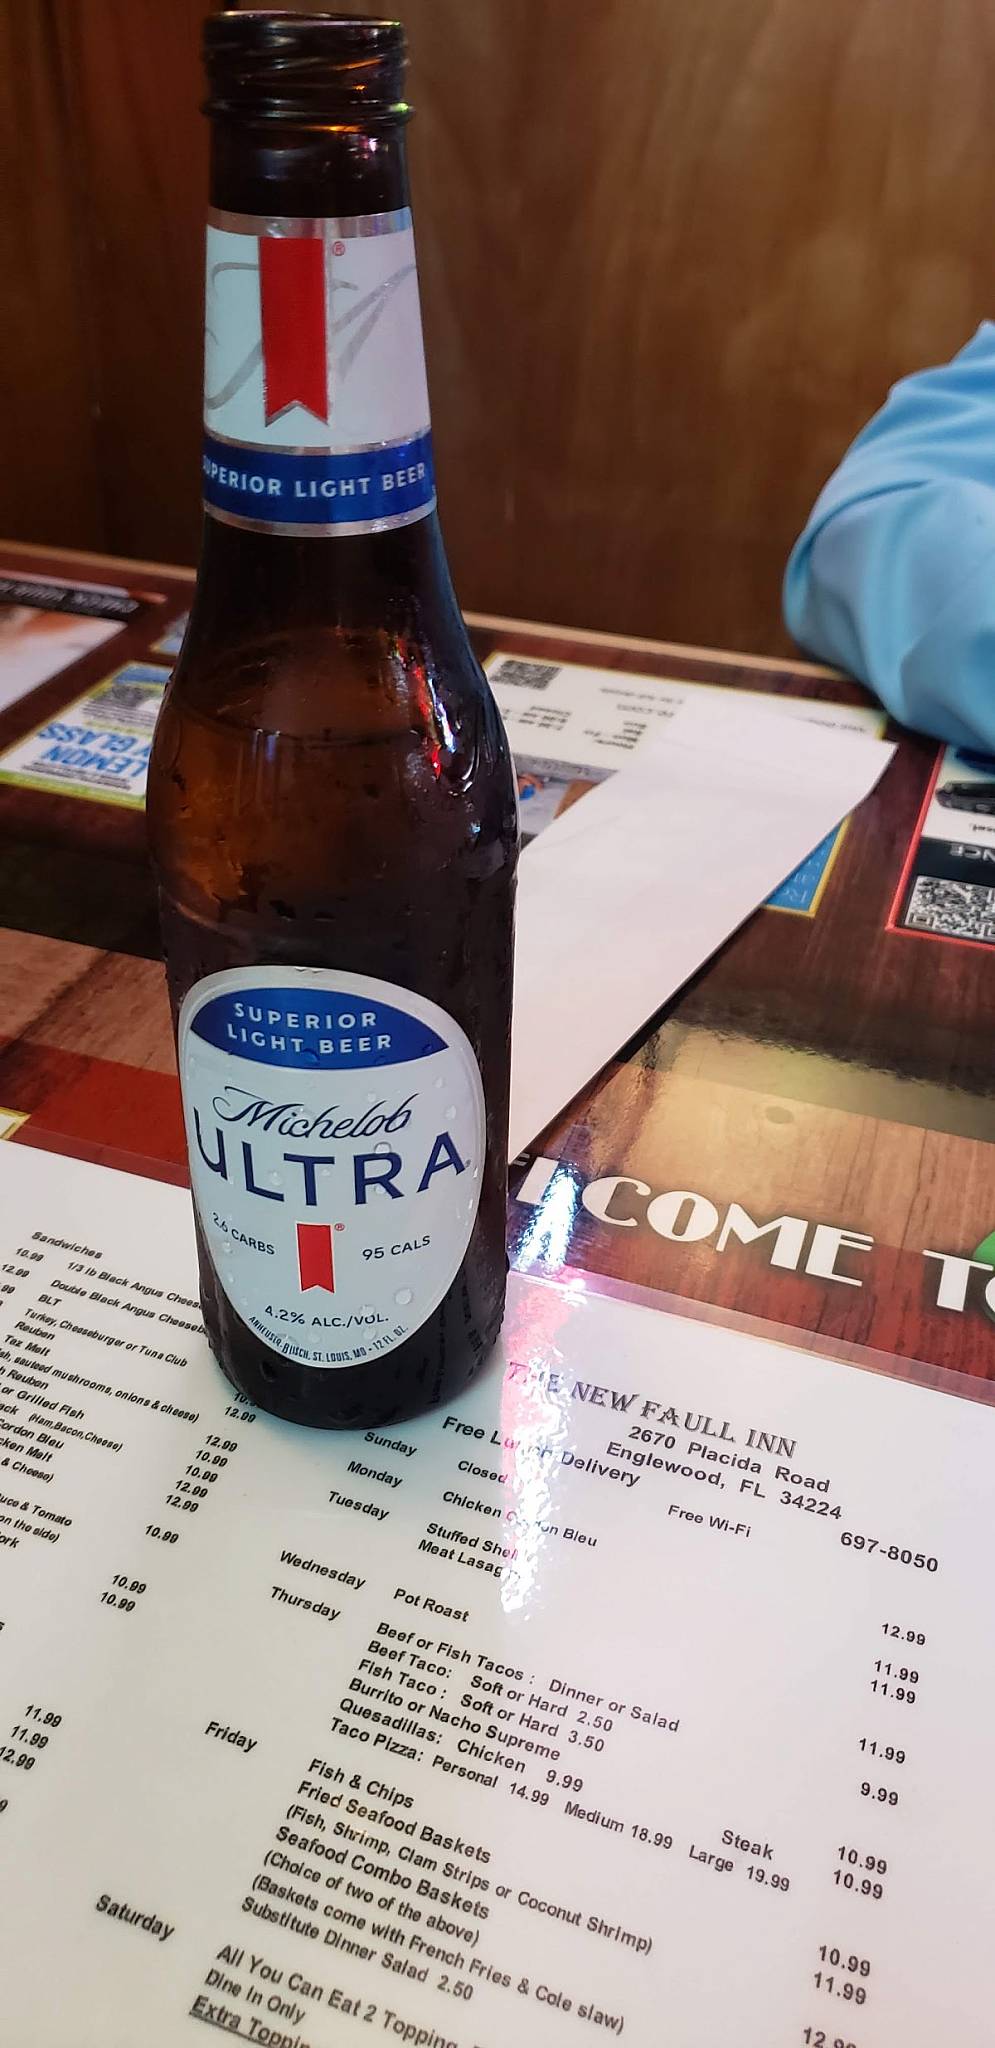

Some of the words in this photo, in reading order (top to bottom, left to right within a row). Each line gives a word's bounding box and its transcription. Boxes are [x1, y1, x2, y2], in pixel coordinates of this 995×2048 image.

[295, 478, 371, 498] LIGHT
[383, 462, 426, 491] BEER
[39, 723, 138, 751] GLASS
[43, 745, 148, 777] LEMON
[234, 1003, 377, 1028] SUPERIOR
[227, 1023, 302, 1050] LIGHT
[320, 1034, 392, 1053] BEER
[213, 1086, 419, 1140] Michelob
[193, 1106, 466, 1206] ULTRA
[31, 1231, 103, 1260] Sandwiches
[231, 1228, 275, 1255] CARBS
[362, 1247, 385, 1261] 95
[391, 1235, 431, 1256] CALS
[67, 1261, 84, 1273] 1/3
[85, 1265, 97, 1277] lb
[130, 1281, 164, 1301] Angus
[922, 1249, 995, 1312] T
[38, 1293, 63, 1307] BLT
[50, 1279, 87, 1297] Double
[89, 1291, 120, 1309] Black
[121, 1301, 156, 1321] Angus
[15, 1321, 56, 1341] Reuben
[265, 1305, 305, 1325] 4.2%
[312, 1313, 389, 1328] ALC./VOL.
[59, 1320, 126, 1347] Cheeseburger
[312, 1352, 324, 1362] ST.
[326, 1351, 352, 1362] LOUIS,
[354, 1346, 367, 1357] MO
[373, 1341, 383, 1351] 12
[7, 1369, 49, 1390] Reuben
[17, 1390, 59, 1411] Grilled
[224, 1405, 256, 1424] 12.99
[571, 1381, 640, 1414] NEW
[641, 1400, 736, 1444] FAULL
[745, 1428, 798, 1459] INN
[195, 1449, 229, 1468] 10.99
[205, 1434, 238, 1452] 12.99
[364, 1431, 418, 1457] Sunday
[443, 1415, 485, 1440] Free
[561, 1449, 641, 1487] Delivery
[185, 1464, 219, 1483] 10.99
[347, 1461, 402, 1488] Monday
[457, 1460, 508, 1484] Closed
[628, 1426, 676, 1450] 2670
[687, 1441, 762, 1475] Placida
[776, 1464, 831, 1494] Road
[175, 1480, 209, 1499] 12.99
[606, 1442, 725, 1490] Englewood,
[740, 1479, 766, 1499] FL
[781, 1490, 843, 1521] 34224
[32, 1504, 73, 1527] Tomato
[165, 1494, 199, 1513] 12.99
[328, 1490, 390, 1521] Tuesday
[442, 1491, 502, 1518] Chicken
[563, 1528, 598, 1548] Bleu
[145, 1524, 180, 1544] 10.99
[418, 1539, 455, 1561] Meat
[426, 1523, 480, 1549] Stuffed
[668, 1505, 704, 1525] Free
[709, 1516, 753, 1539] Wi-Fi
[840, 1531, 939, 1573] 697-8050
[112, 1574, 147, 1594] 10.99
[280, 1550, 366, 1590] Wednesday
[394, 1588, 421, 1608] Pot
[422, 1598, 470, 1623] Roast
[881, 1623, 926, 1646] 12.99
[100, 1591, 136, 1612] 10.99
[270, 1586, 341, 1622] Thursday
[377, 1622, 415, 1644] Beef
[436, 1643, 472, 1664] Fish
[549, 1679, 604, 1707] Dinner
[630, 1706, 680, 1733] Salad
[874, 1660, 919, 1684] 11.99
[368, 1640, 407, 1663] Beef
[408, 1653, 452, 1679] Taco:
[470, 1675, 504, 1696] Soft
[528, 1693, 569, 1718] Hard
[576, 1710, 613, 1732] 2.50
[870, 1680, 916, 1705] 11.99
[24, 1704, 62, 1728] 11.99
[349, 1678, 404, 1706] Burrito
[428, 1705, 482, 1734] Nacho
[485, 1724, 561, 1762] Supreme
[859, 1738, 906, 1764] 11.99
[358, 1659, 394, 1681] Fish
[460, 1693, 494, 1715] Soft
[518, 1712, 560, 1737] Hard
[568, 1730, 605, 1752] 3.50
[10, 1725, 49, 1749] 11.99
[339, 1698, 443, 1745] Quesadillas:
[457, 1739, 526, 1774] Chicken
[545, 1770, 584, 1793] 9.99
[860, 1782, 899, 1806] 9.99
[205, 1721, 258, 1754] Friday
[308, 1758, 346, 1784] Fish
[366, 1780, 415, 1809] Chips
[330, 1717, 370, 1743] Taco
[373, 1733, 424, 1762] Pizza:
[432, 1755, 499, 1789] Personal
[508, 1782, 550, 1807] 14.99
[564, 1801, 625, 1834] Medium
[631, 1824, 674, 1850] 18.99
[688, 1844, 735, 1872] Large
[746, 1866, 791, 1893] 19.99
[297, 1780, 343, 1808] Fried
[345, 1799, 418, 1837] Seafood
[420, 1826, 491, 1864] Baskets
[832, 1869, 884, 1900] 10.99
[722, 1829, 775, 1861] Steak
[837, 1845, 888, 1875] 10.99
[275, 1826, 348, 1865] Seafood
[351, 1854, 412, 1890] Combo
[416, 1879, 490, 1920] Baskets
[286, 1803, 327, 1832] (Fish,
[333, 1821, 392, 1857] Shrimp,
[398, 1845, 438, 1872] Clam
[442, 1862, 490, 1892] Strips
[517, 1891, 583, 1927] Coconut
[586, 1916, 653, 1956] Shrimp)
[263, 1849, 321, 1883] (Choice
[345, 1881, 374, 1904] two
[397, 1903, 422, 1923] the
[426, 1913, 480, 1948] above)
[818, 1945, 871, 1978] 10.99
[95, 1894, 175, 1942] Saturday
[241, 1896, 319, 1939] Substitute
[324, 1929, 377, 1962] Dinner
[381, 1952, 429, 1983] Salad
[437, 1975, 474, 2001] 2.50
[813, 1971, 867, 2005] 11.99
[251, 1873, 319, 1912] (Baskets
[323, 1905, 366, 1931] come
[371, 1922, 405, 1946] with
[409, 1936, 464, 1970] French
[469, 1958, 511, 1988] Fries
[536, 1985, 572, 2012] Cole
[577, 2003, 625, 2035] slaw)
[216, 1944, 244, 1968] All
[249, 1955, 283, 1985] You
[288, 1973, 324, 2001] Can
[327, 1989, 359, 2017] Eat
[204, 1968, 242, 1997] Dine
[267, 1994, 306, 2026] Only
